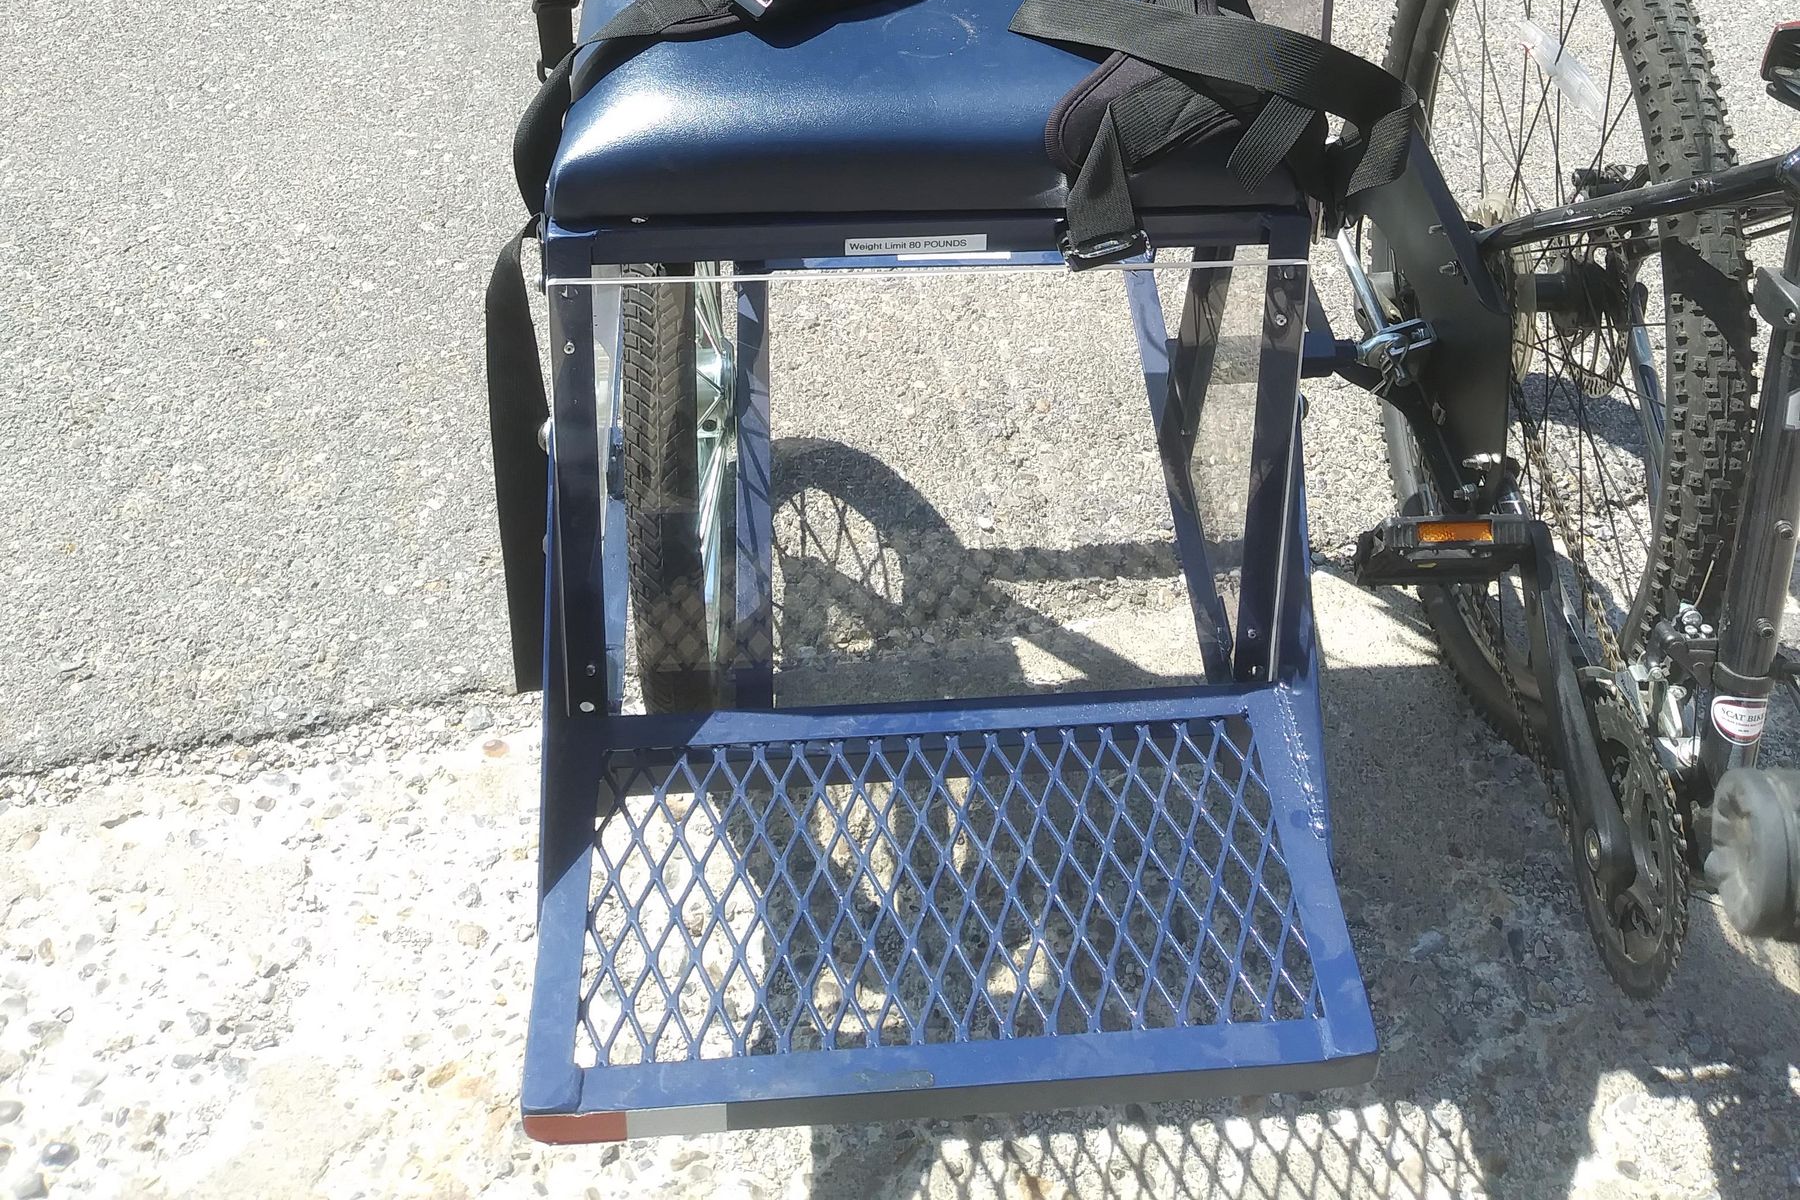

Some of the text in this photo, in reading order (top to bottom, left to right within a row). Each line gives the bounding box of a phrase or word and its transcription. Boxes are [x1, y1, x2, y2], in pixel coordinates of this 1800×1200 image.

[849, 238, 968, 251] Weight Limit 80 POUNDS
